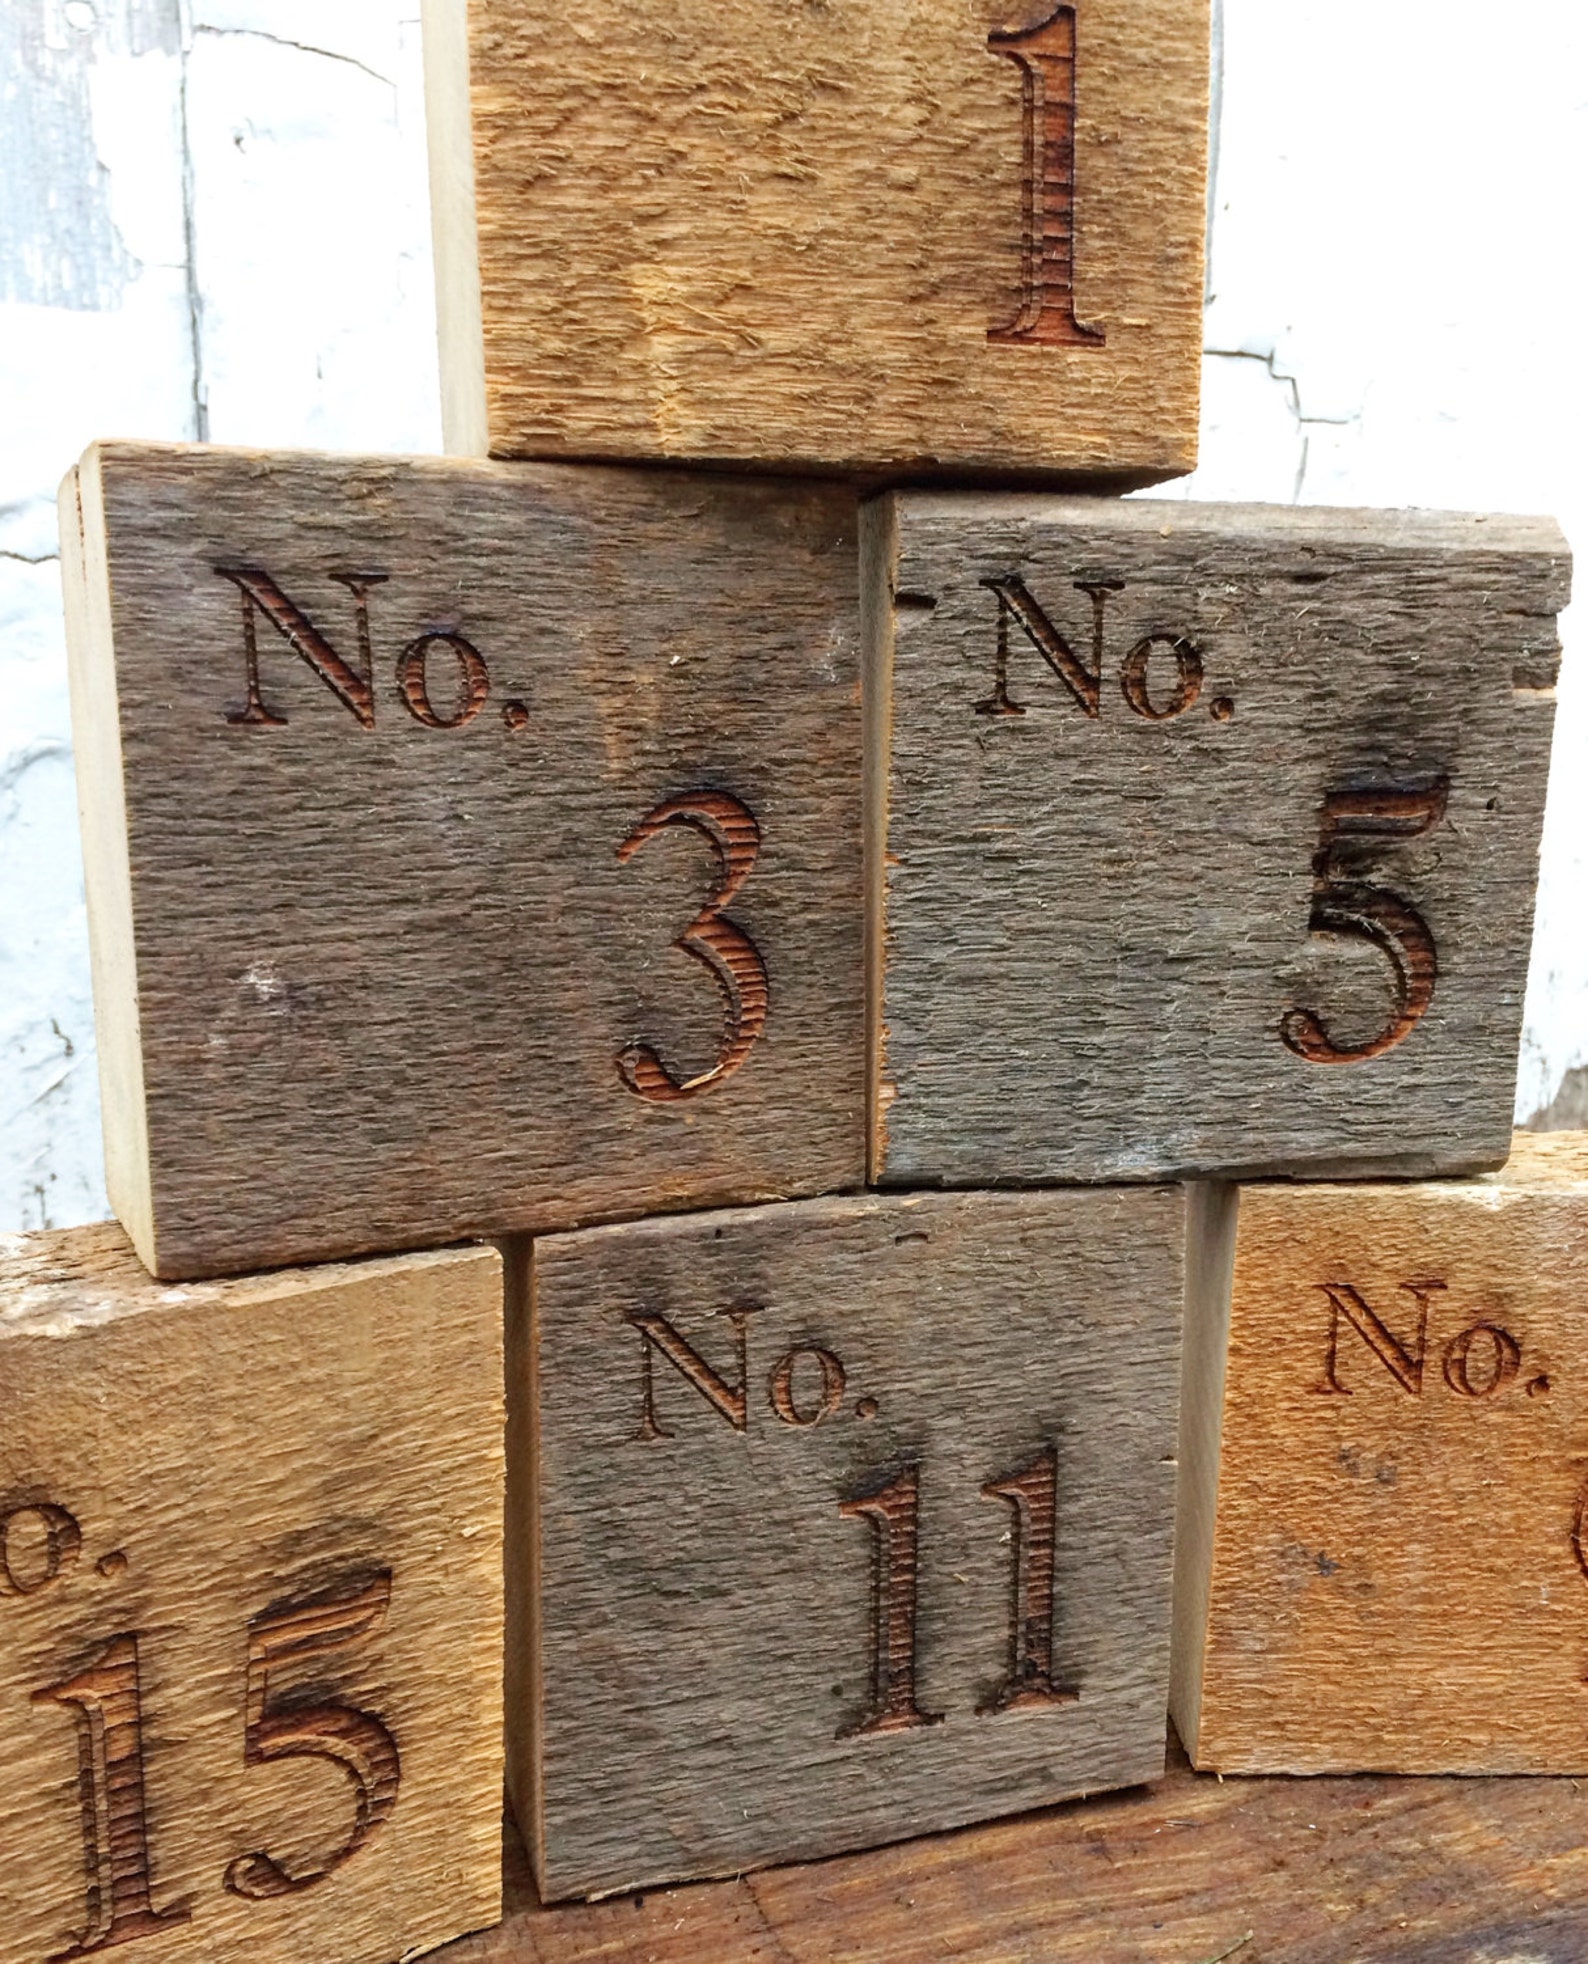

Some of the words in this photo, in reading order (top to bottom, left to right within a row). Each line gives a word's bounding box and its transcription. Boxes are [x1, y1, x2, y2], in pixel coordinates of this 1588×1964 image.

[986, 4, 1106, 347] 1
[213, 566, 530, 732] No.
[978, 572, 1236, 724] No.
[615, 788, 769, 1102] 3
[1278, 768, 1452, 1066] 5
[622, 1304, 880, 1440] No.
[1307, 1280, 1551, 1397] No.
[0, 1502, 128, 1595] o.
[834, 1444, 1081, 1742] 11
[30, 1564, 402, 1964] 15
